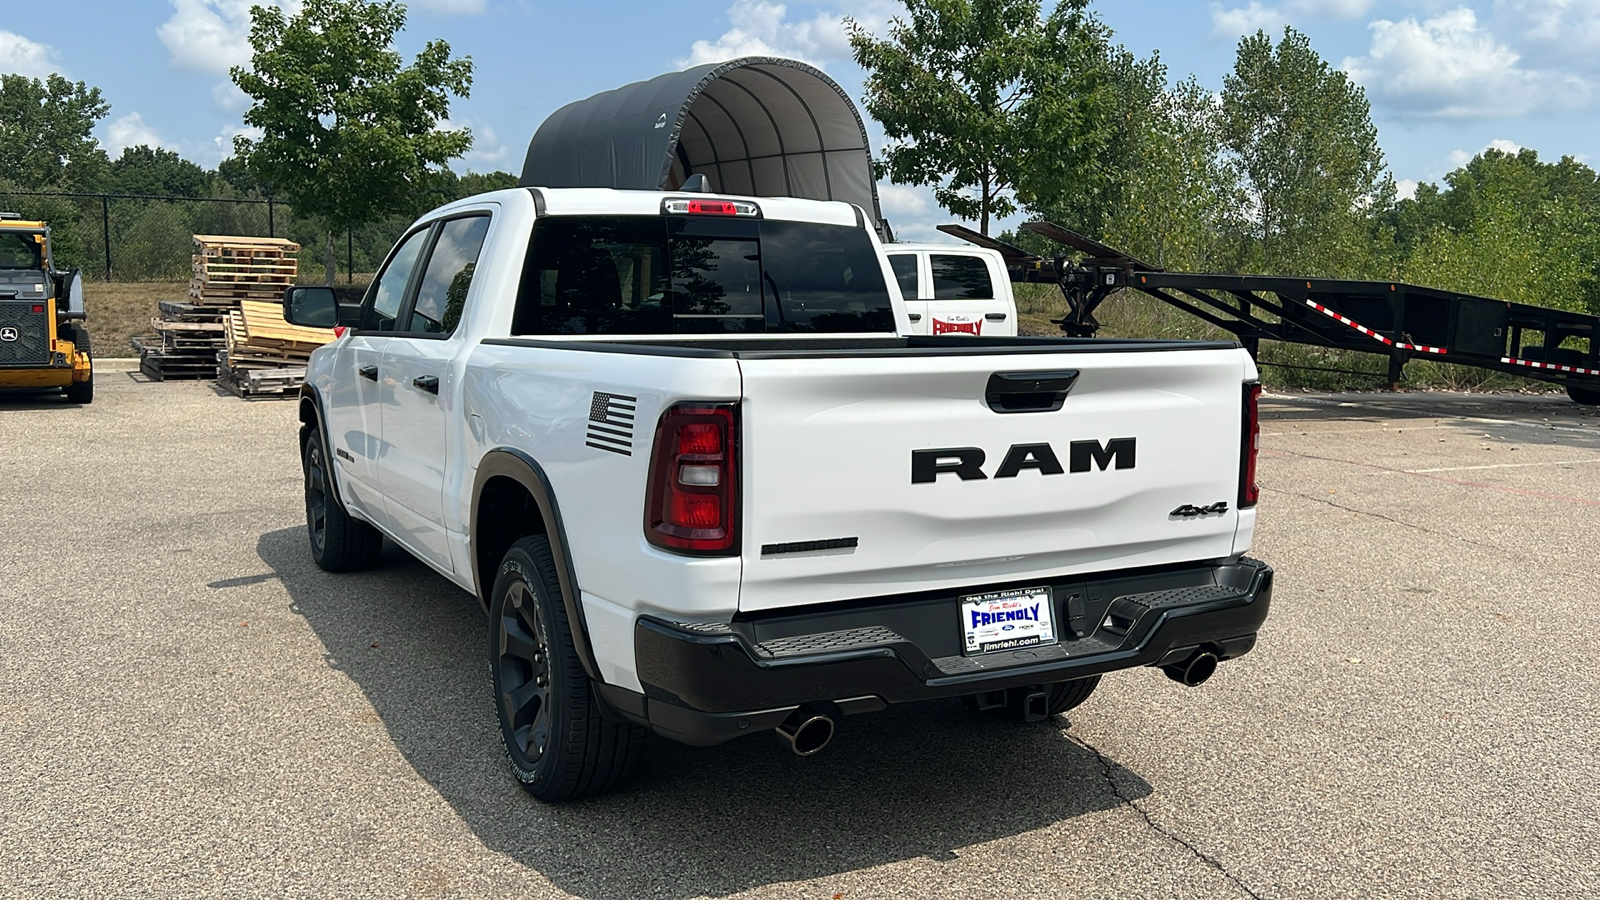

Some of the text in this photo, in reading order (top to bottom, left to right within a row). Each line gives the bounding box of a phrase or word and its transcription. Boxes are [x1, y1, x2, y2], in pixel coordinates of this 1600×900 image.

[932, 317, 983, 336] FRIENDLY
[911, 436, 1137, 485] RAM
[1168, 501, 1229, 518] 4x4
[971, 602, 1040, 629] FRIENDLY
[988, 604, 1000, 612] Jim
[983, 636, 1039, 652] jimriehl.com
